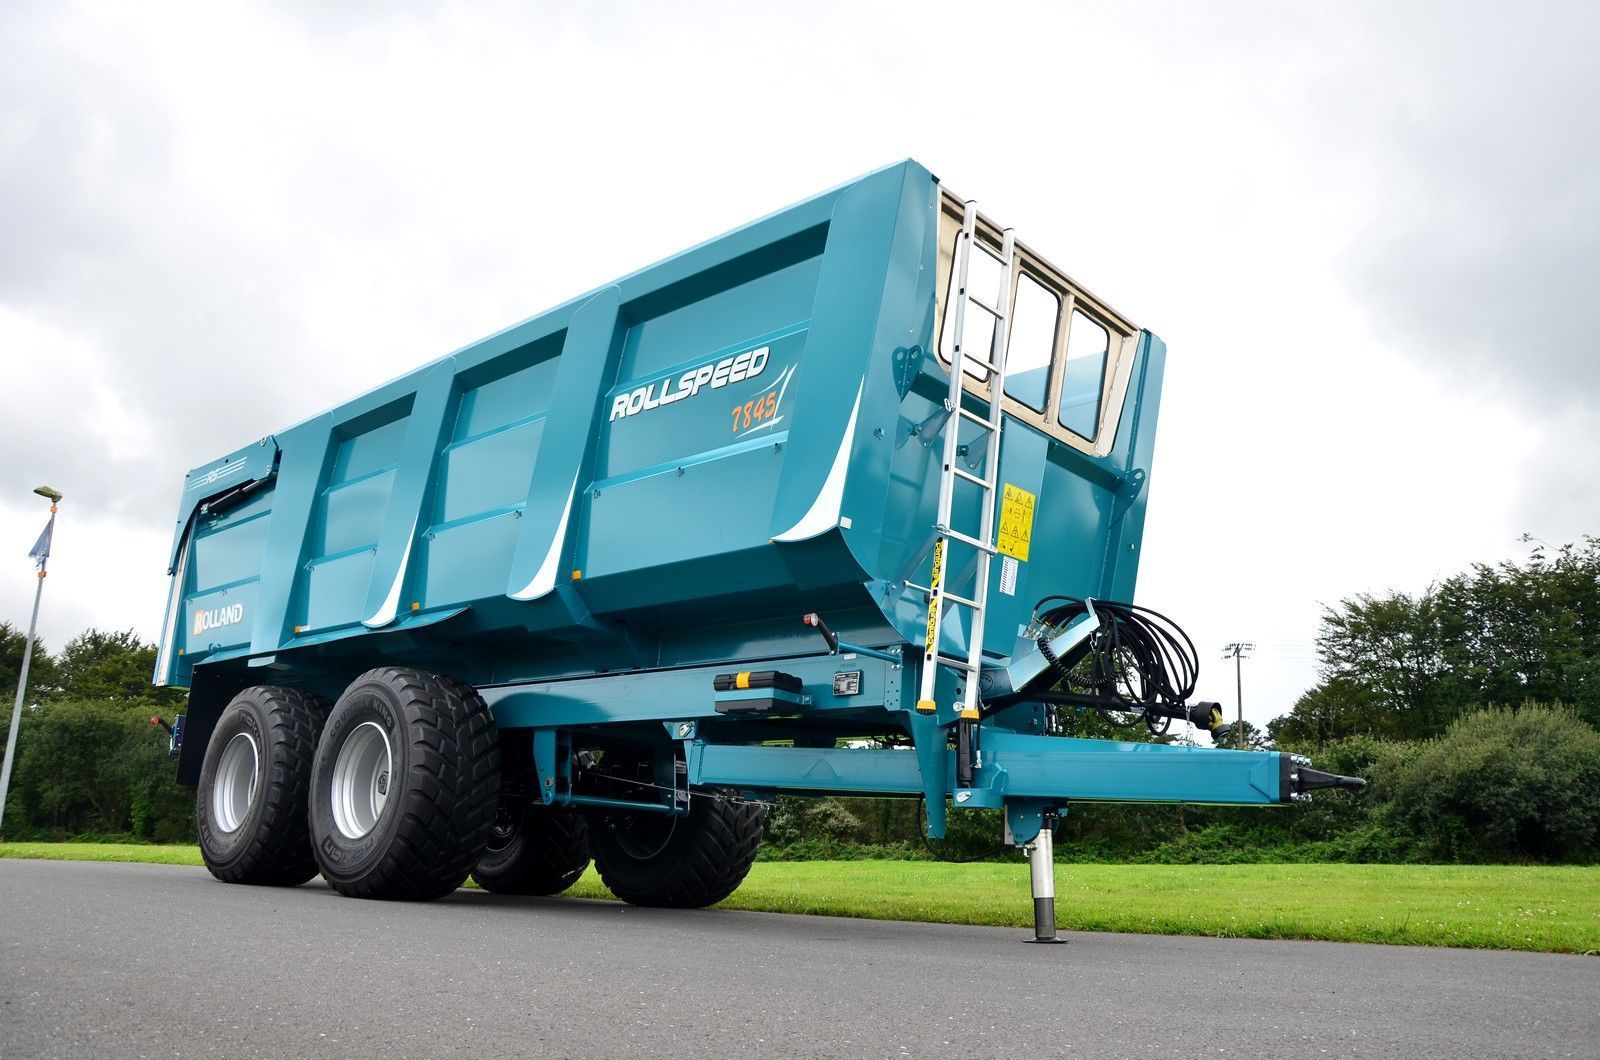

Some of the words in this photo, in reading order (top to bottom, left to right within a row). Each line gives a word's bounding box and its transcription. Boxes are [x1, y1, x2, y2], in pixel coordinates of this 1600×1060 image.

[609, 346, 770, 422] ROLLSPEED
[731, 390, 777, 432] 7845
[193, 603, 243, 635] ROLLAND
